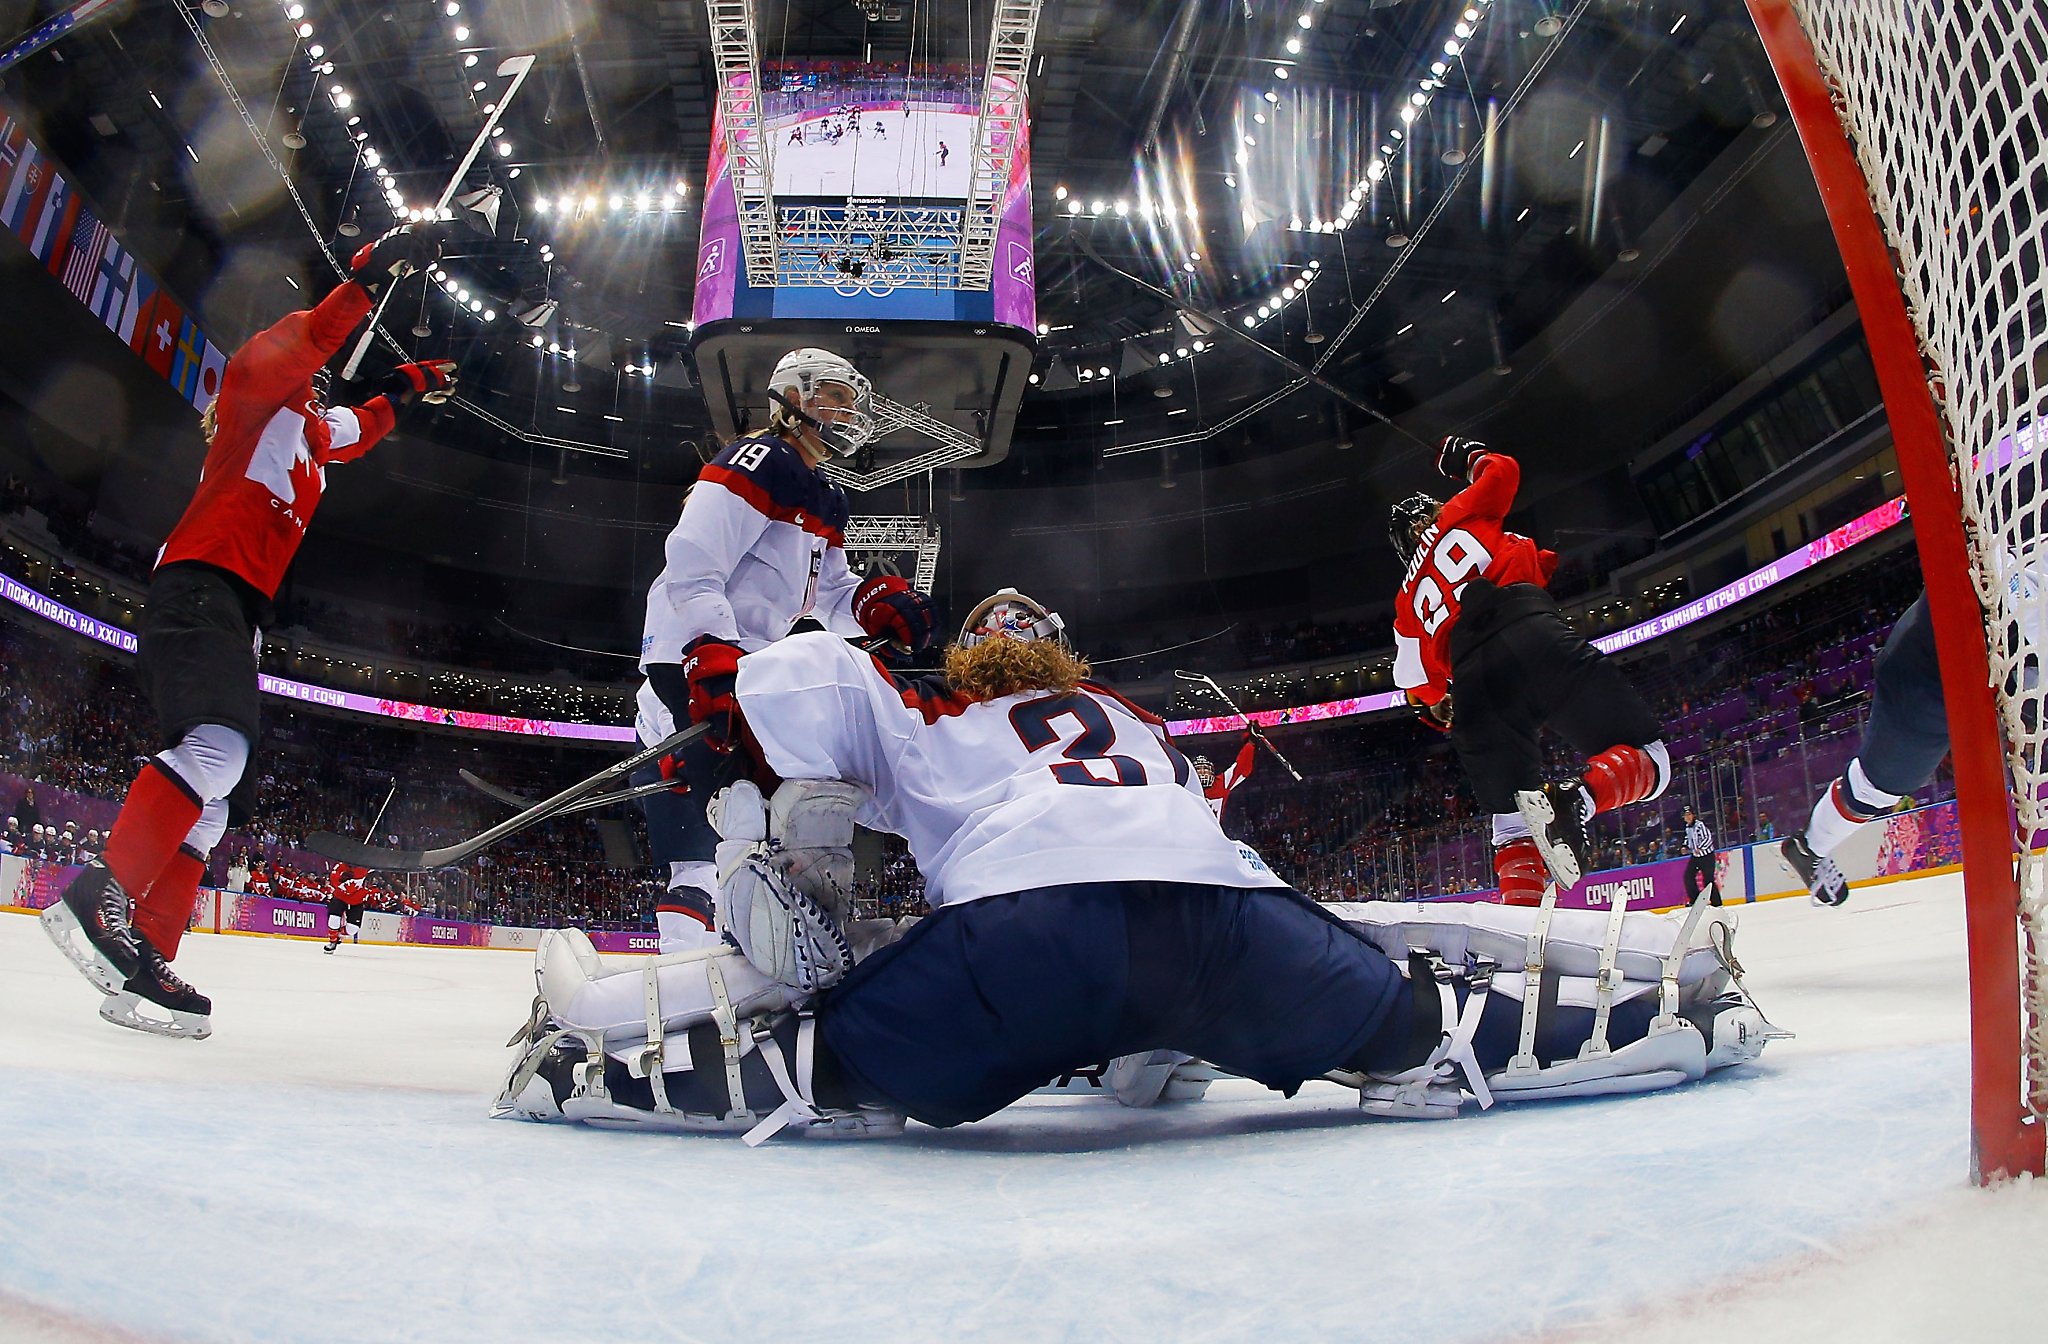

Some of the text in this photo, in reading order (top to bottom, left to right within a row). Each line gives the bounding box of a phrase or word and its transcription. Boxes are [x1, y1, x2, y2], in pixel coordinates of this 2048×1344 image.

[727, 443, 771, 472] 19
[1413, 528, 1493, 638] 29
[6, 582, 78, 628] ПОЖАЛОВАТЬ
[80, 617, 95, 636] НА
[1659, 601, 1705, 632] ЗИМНИЕ
[1705, 586, 1737, 613] ИГРЫ
[1748, 565, 1779, 592] СОЧИ
[263, 677, 298, 697] ИГРЫ
[313, 689, 346, 706] СОЧИ
[620, 746, 658, 769] EASTON
[1621, 876, 1655, 901] 2014
[273, 908, 315, 929] СОЧИ 2014
